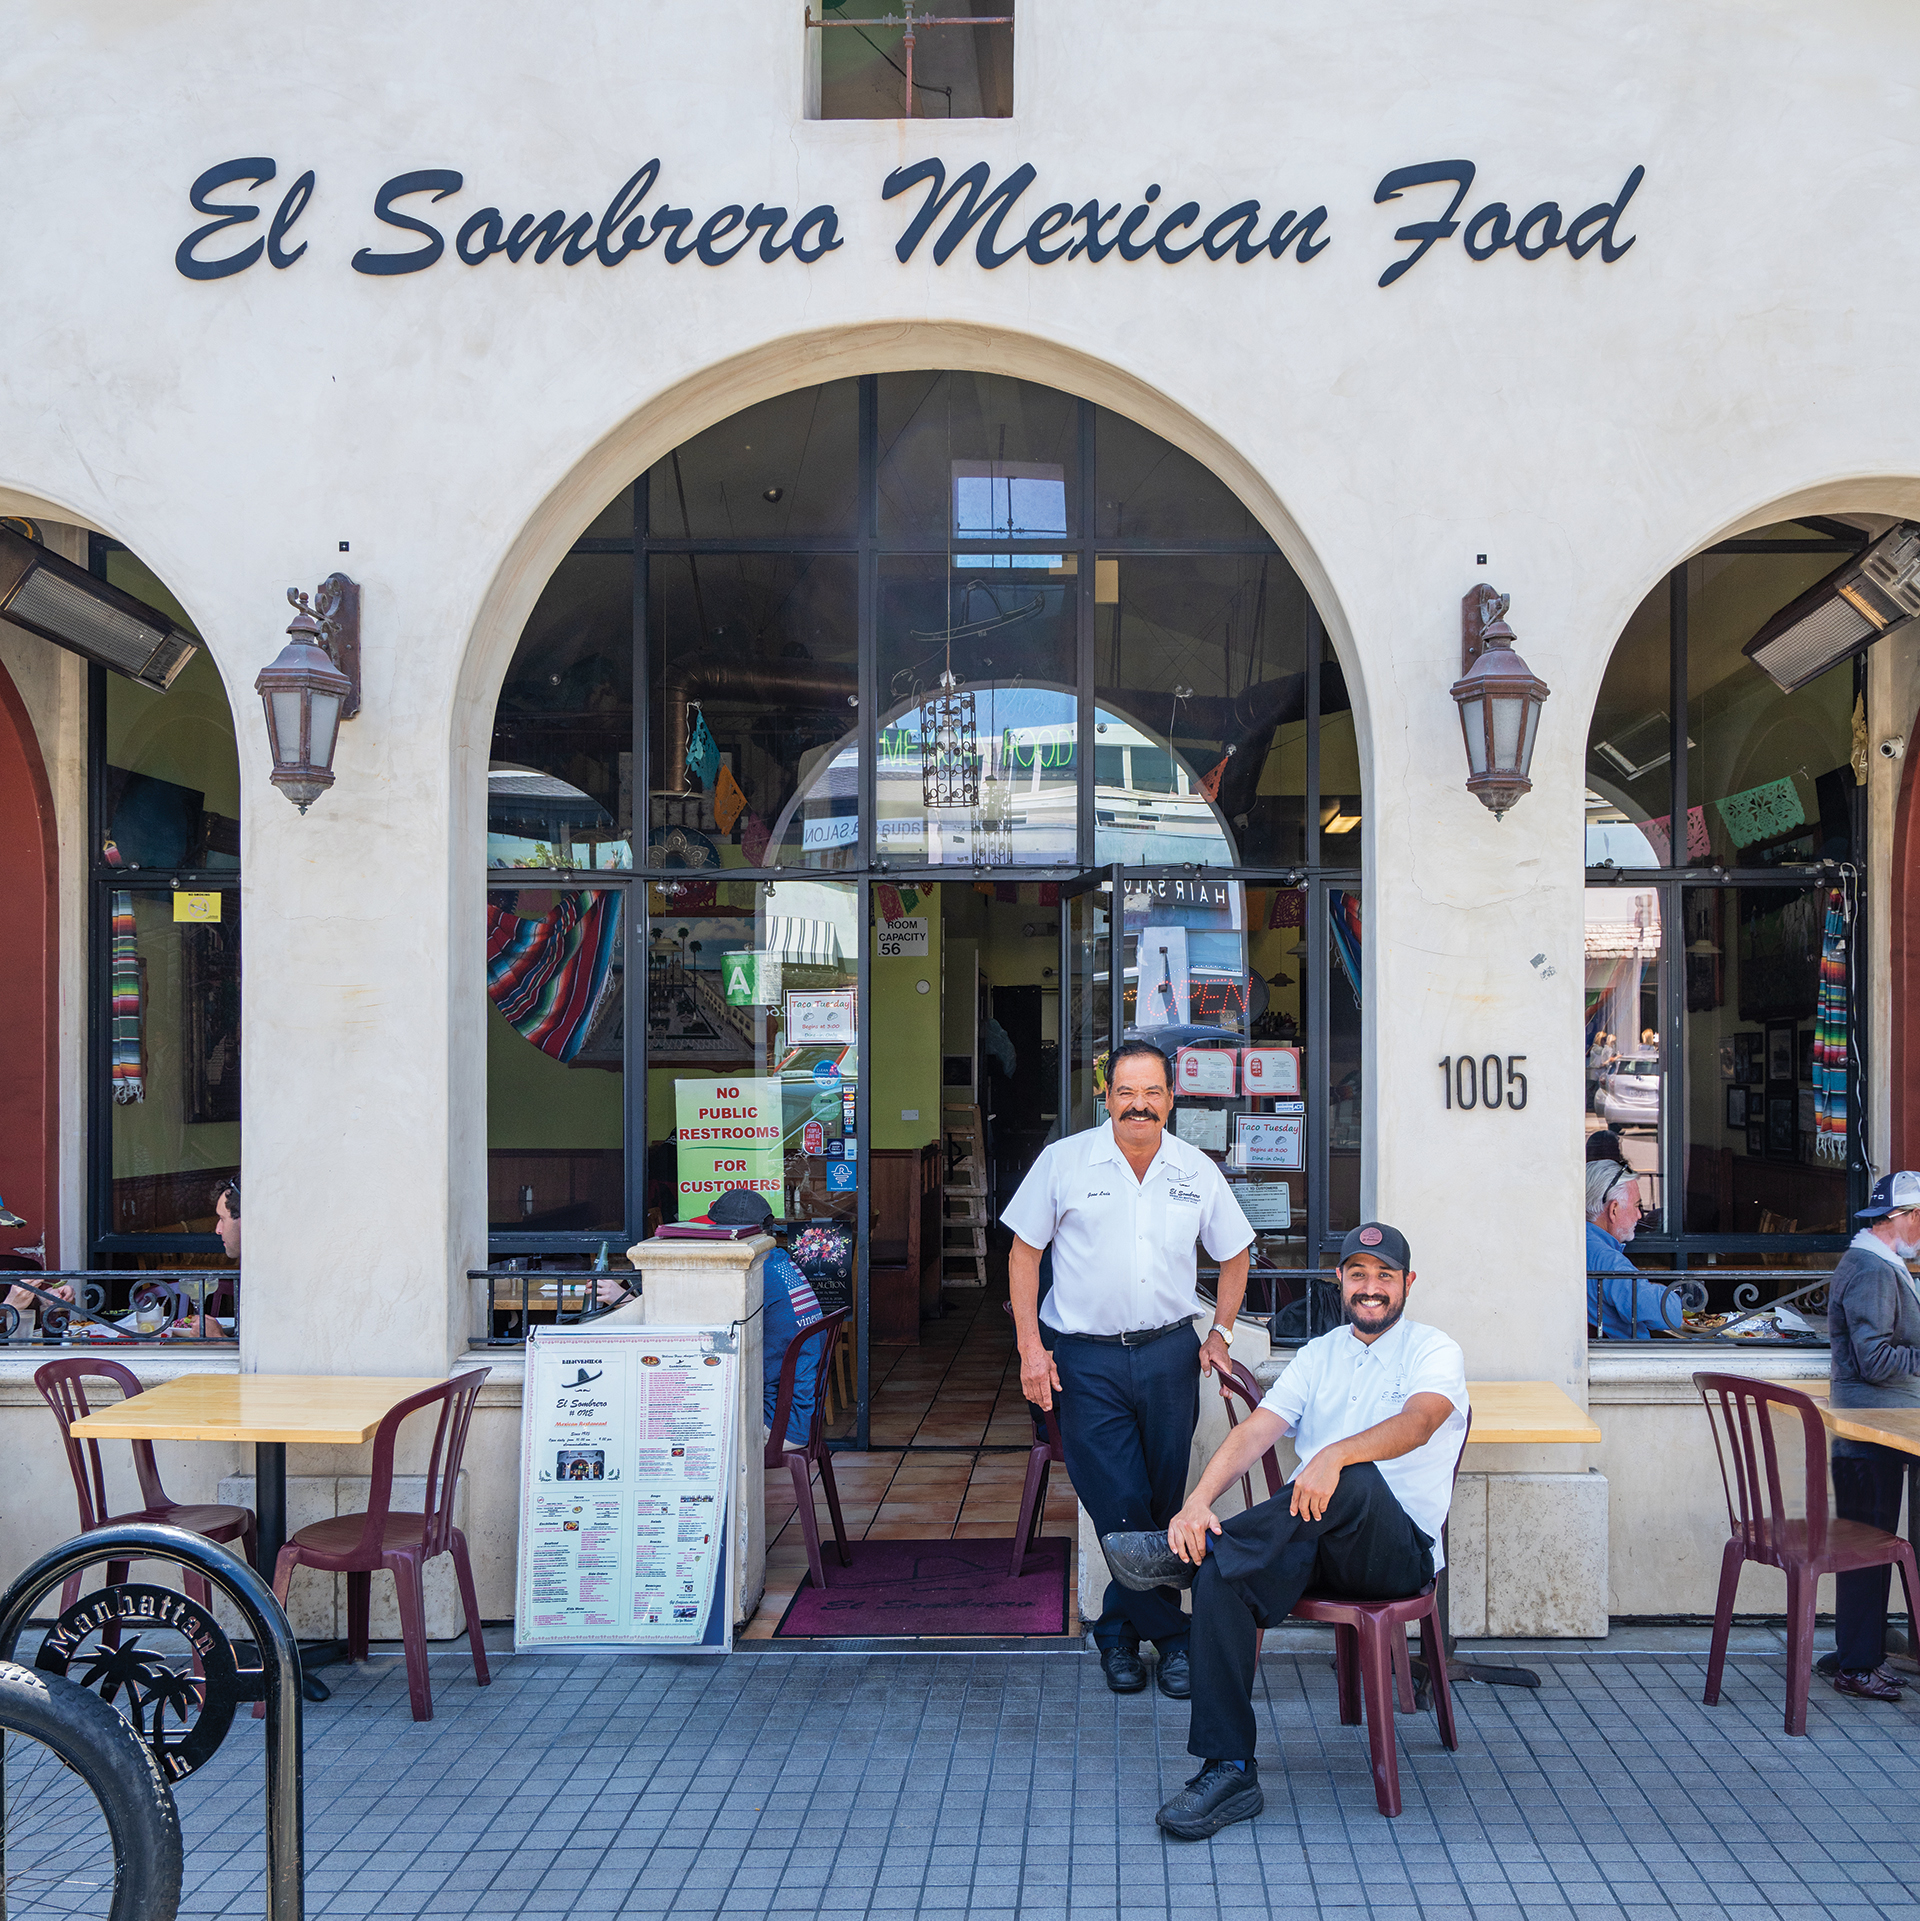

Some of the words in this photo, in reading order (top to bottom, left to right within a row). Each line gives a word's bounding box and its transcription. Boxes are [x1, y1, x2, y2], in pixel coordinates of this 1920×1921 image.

[174, 155, 316, 282] El
[351, 157, 844, 276] Sombrero
[881, 156, 1331, 270] Mexican
[1373, 158, 1646, 288] Food
[1003, 728, 1074, 768] FOOD
[887, 920, 918, 929] ROOM
[878, 932, 926, 942] CAPACITY
[881, 942, 901, 956] 56
[727, 966, 751, 996] A
[791, 1000, 811, 1008] Taco
[1147, 977, 1254, 1017] OPEN
[1438, 1054, 1528, 1111] 1005
[716, 1087, 740, 1099] NO
[698, 1106, 759, 1120] PUBLIC
[679, 1126, 780, 1141] RESTROOMS
[1240, 1123, 1261, 1131] Taco
[1263, 1124, 1299, 1134] Tuesday
[713, 1159, 747, 1172] FOR
[680, 1178, 781, 1194] CUSTOMERS
[556, 1398, 569, 1409] El
[570, 1398, 608, 1409] Sombrero
[576, 1409, 595, 1417] ONE
[45, 1587, 217, 1659] Manhattan
